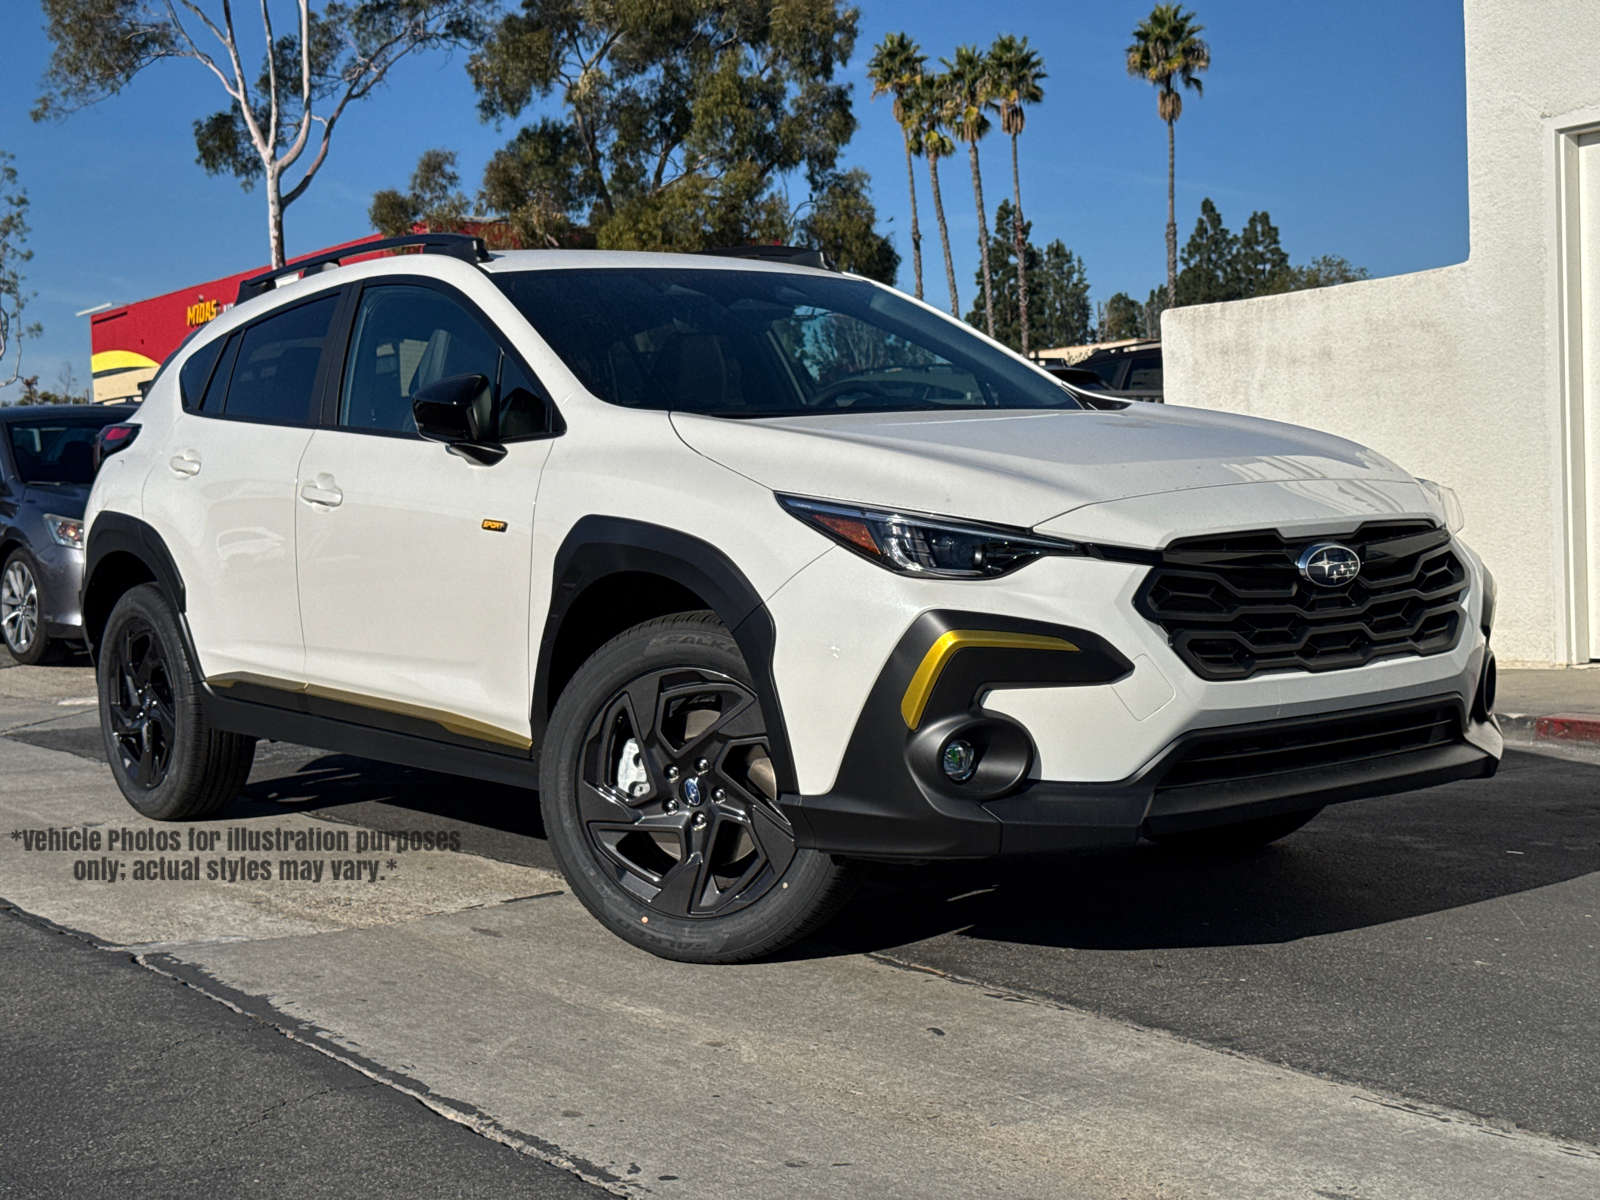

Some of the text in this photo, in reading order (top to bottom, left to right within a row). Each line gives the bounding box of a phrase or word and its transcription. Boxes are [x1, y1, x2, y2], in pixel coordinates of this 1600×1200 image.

[187, 299, 217, 327] MIDAS
[483, 520, 505, 530] SPORT
[663, 635, 740, 656] FALKE
